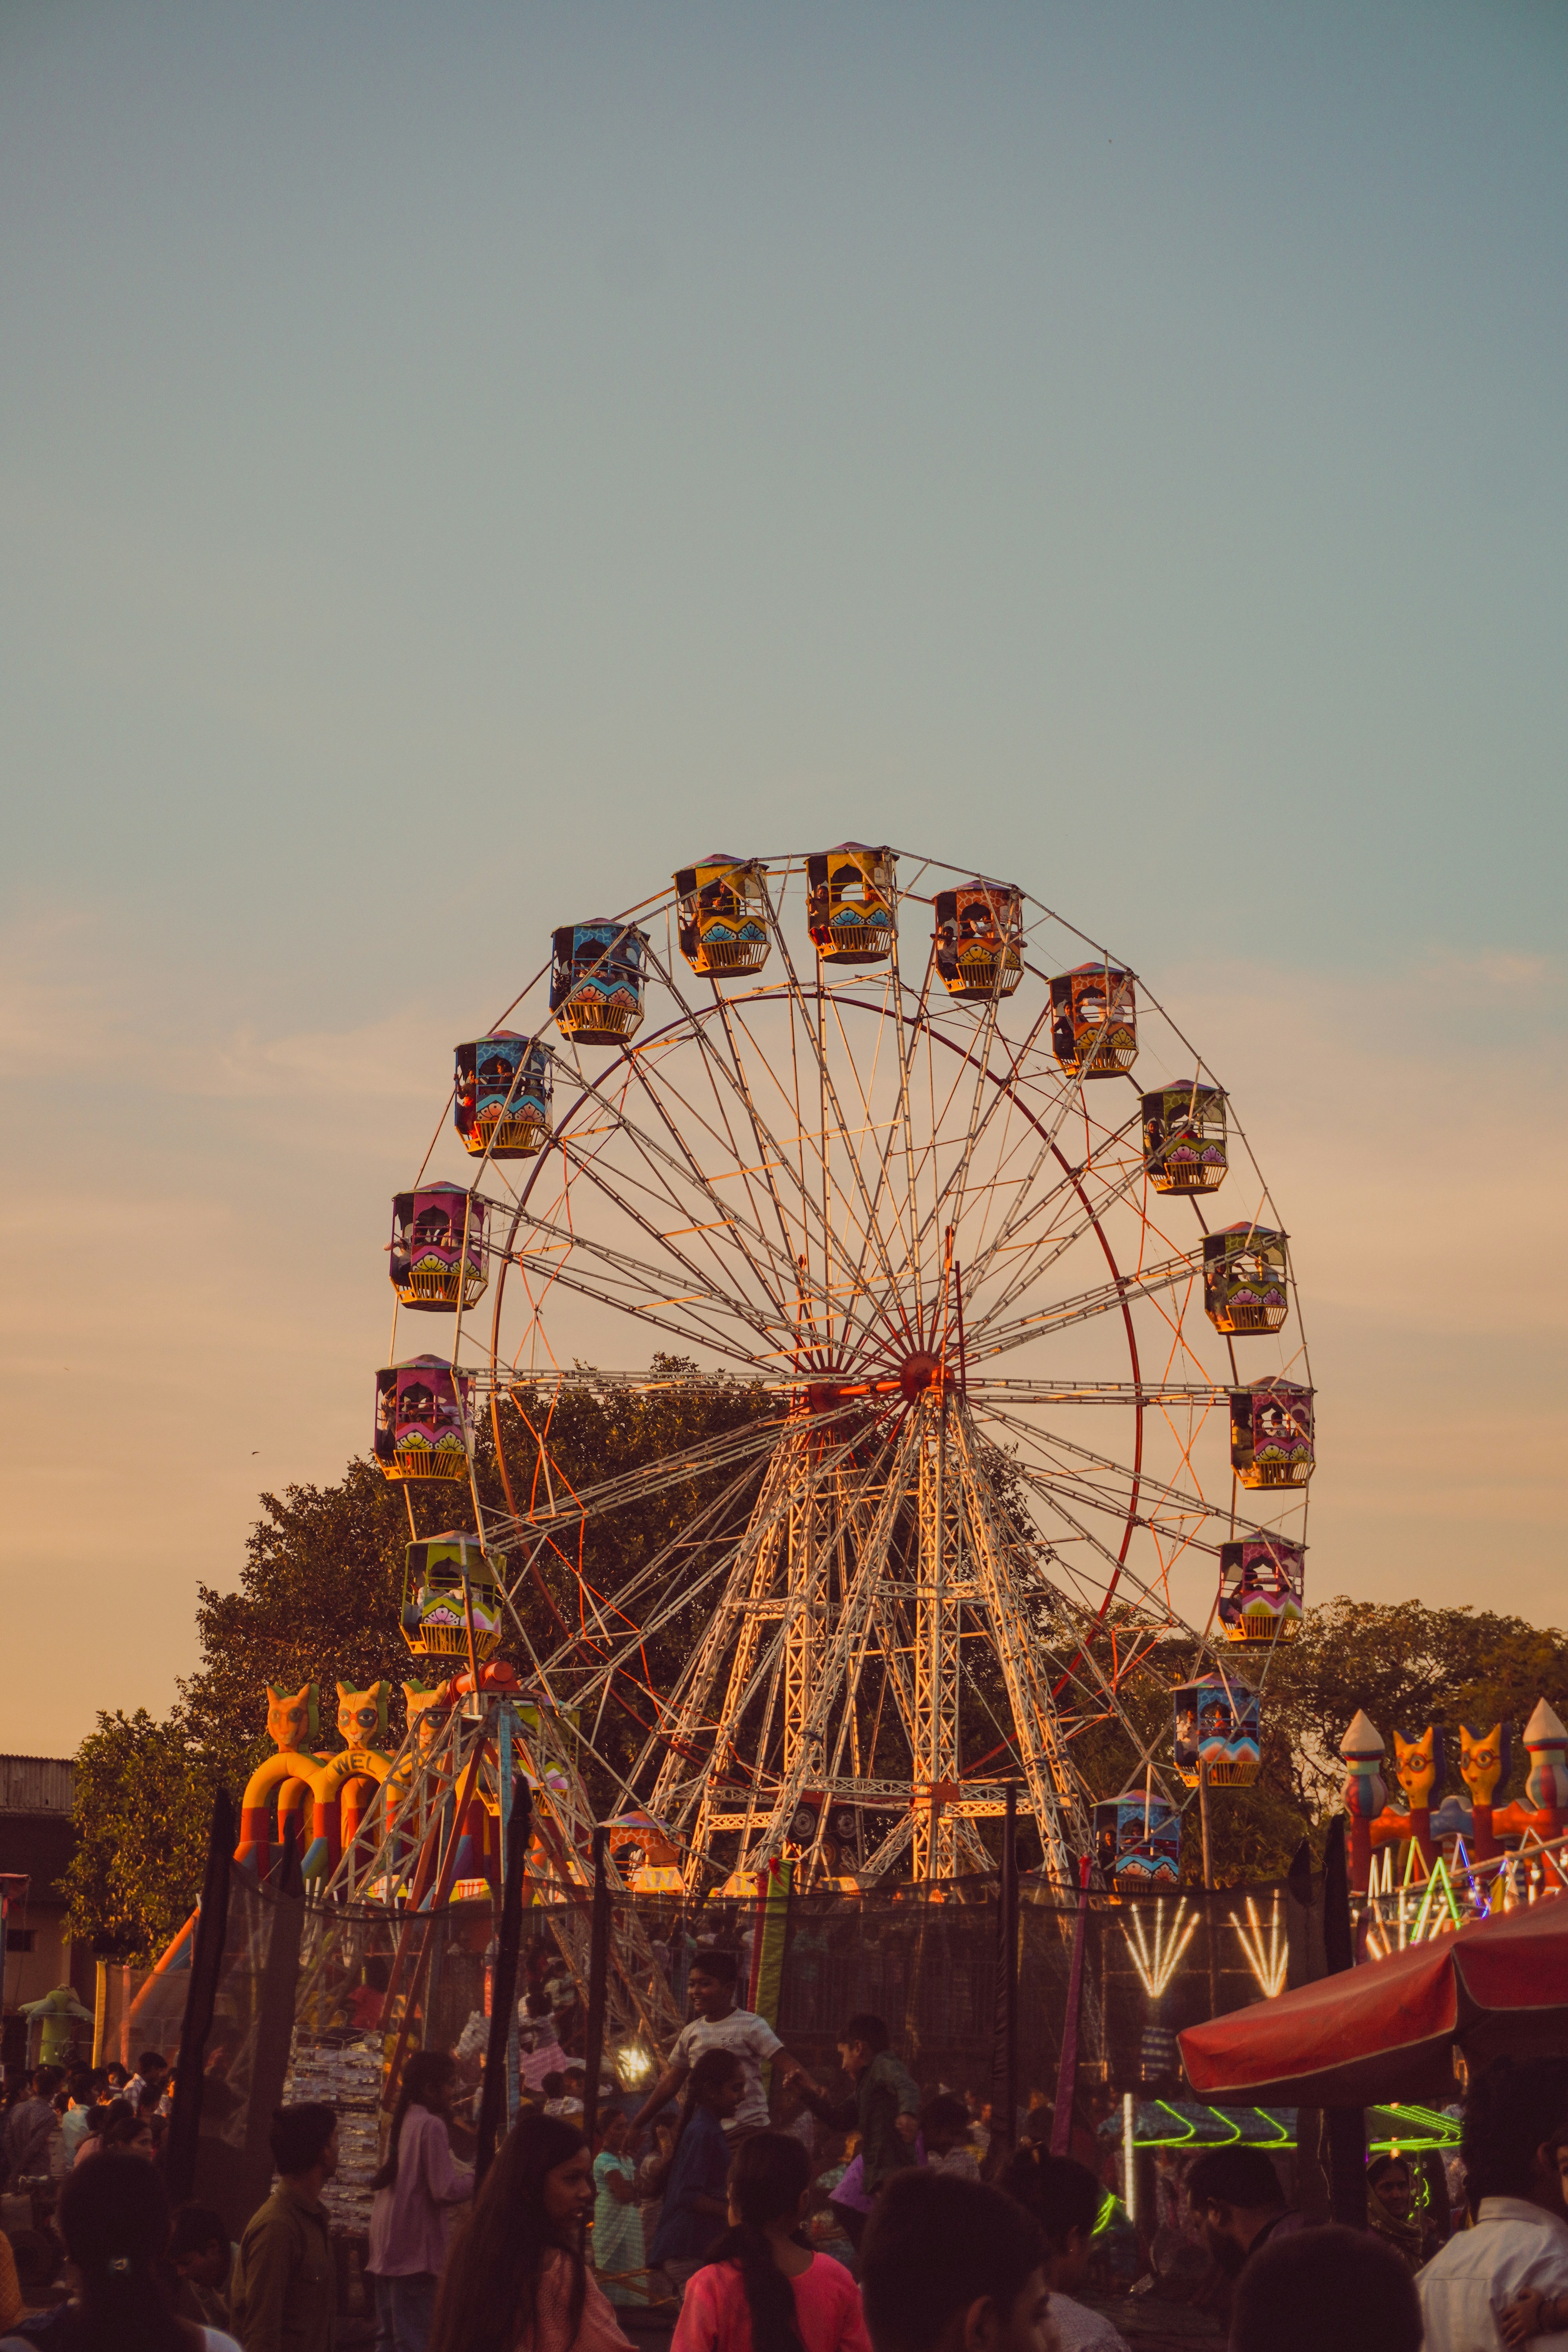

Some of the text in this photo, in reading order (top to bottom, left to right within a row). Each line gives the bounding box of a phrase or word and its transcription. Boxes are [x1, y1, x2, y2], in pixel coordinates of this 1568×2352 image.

[332, 1753, 376, 1776] WEL
[644, 1870, 674, 1888] IN
[458, 1881, 484, 1899] OUT
